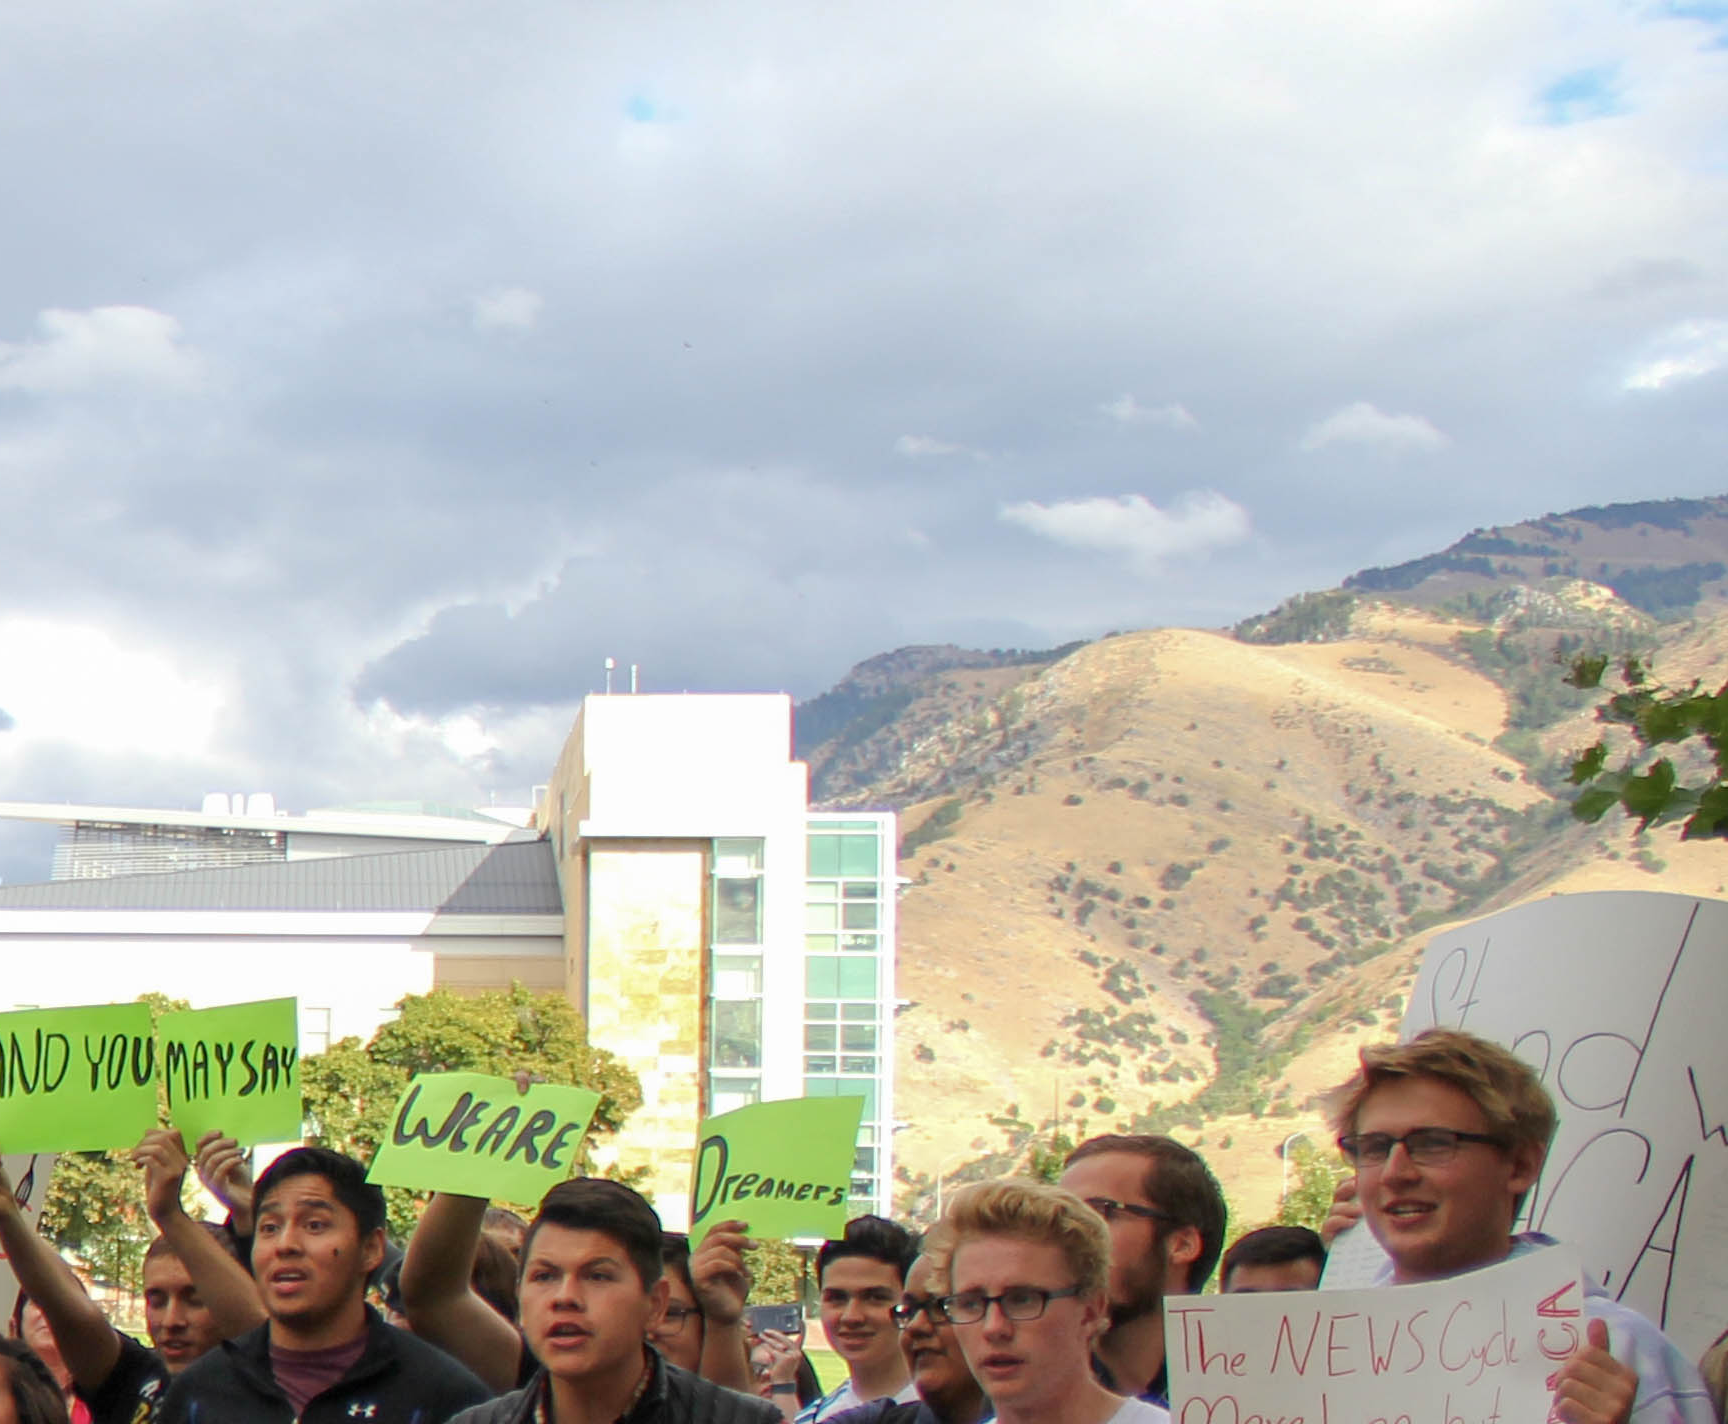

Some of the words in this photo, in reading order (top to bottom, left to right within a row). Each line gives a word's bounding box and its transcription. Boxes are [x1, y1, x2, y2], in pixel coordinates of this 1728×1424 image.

[85, 1033, 154, 1093] YOU
[166, 1040, 234, 1109] MAY
[238, 1039, 297, 1097] SAY
[1168, 1308, 1247, 1376] The
[1271, 1309, 1428, 1377] NEWS
